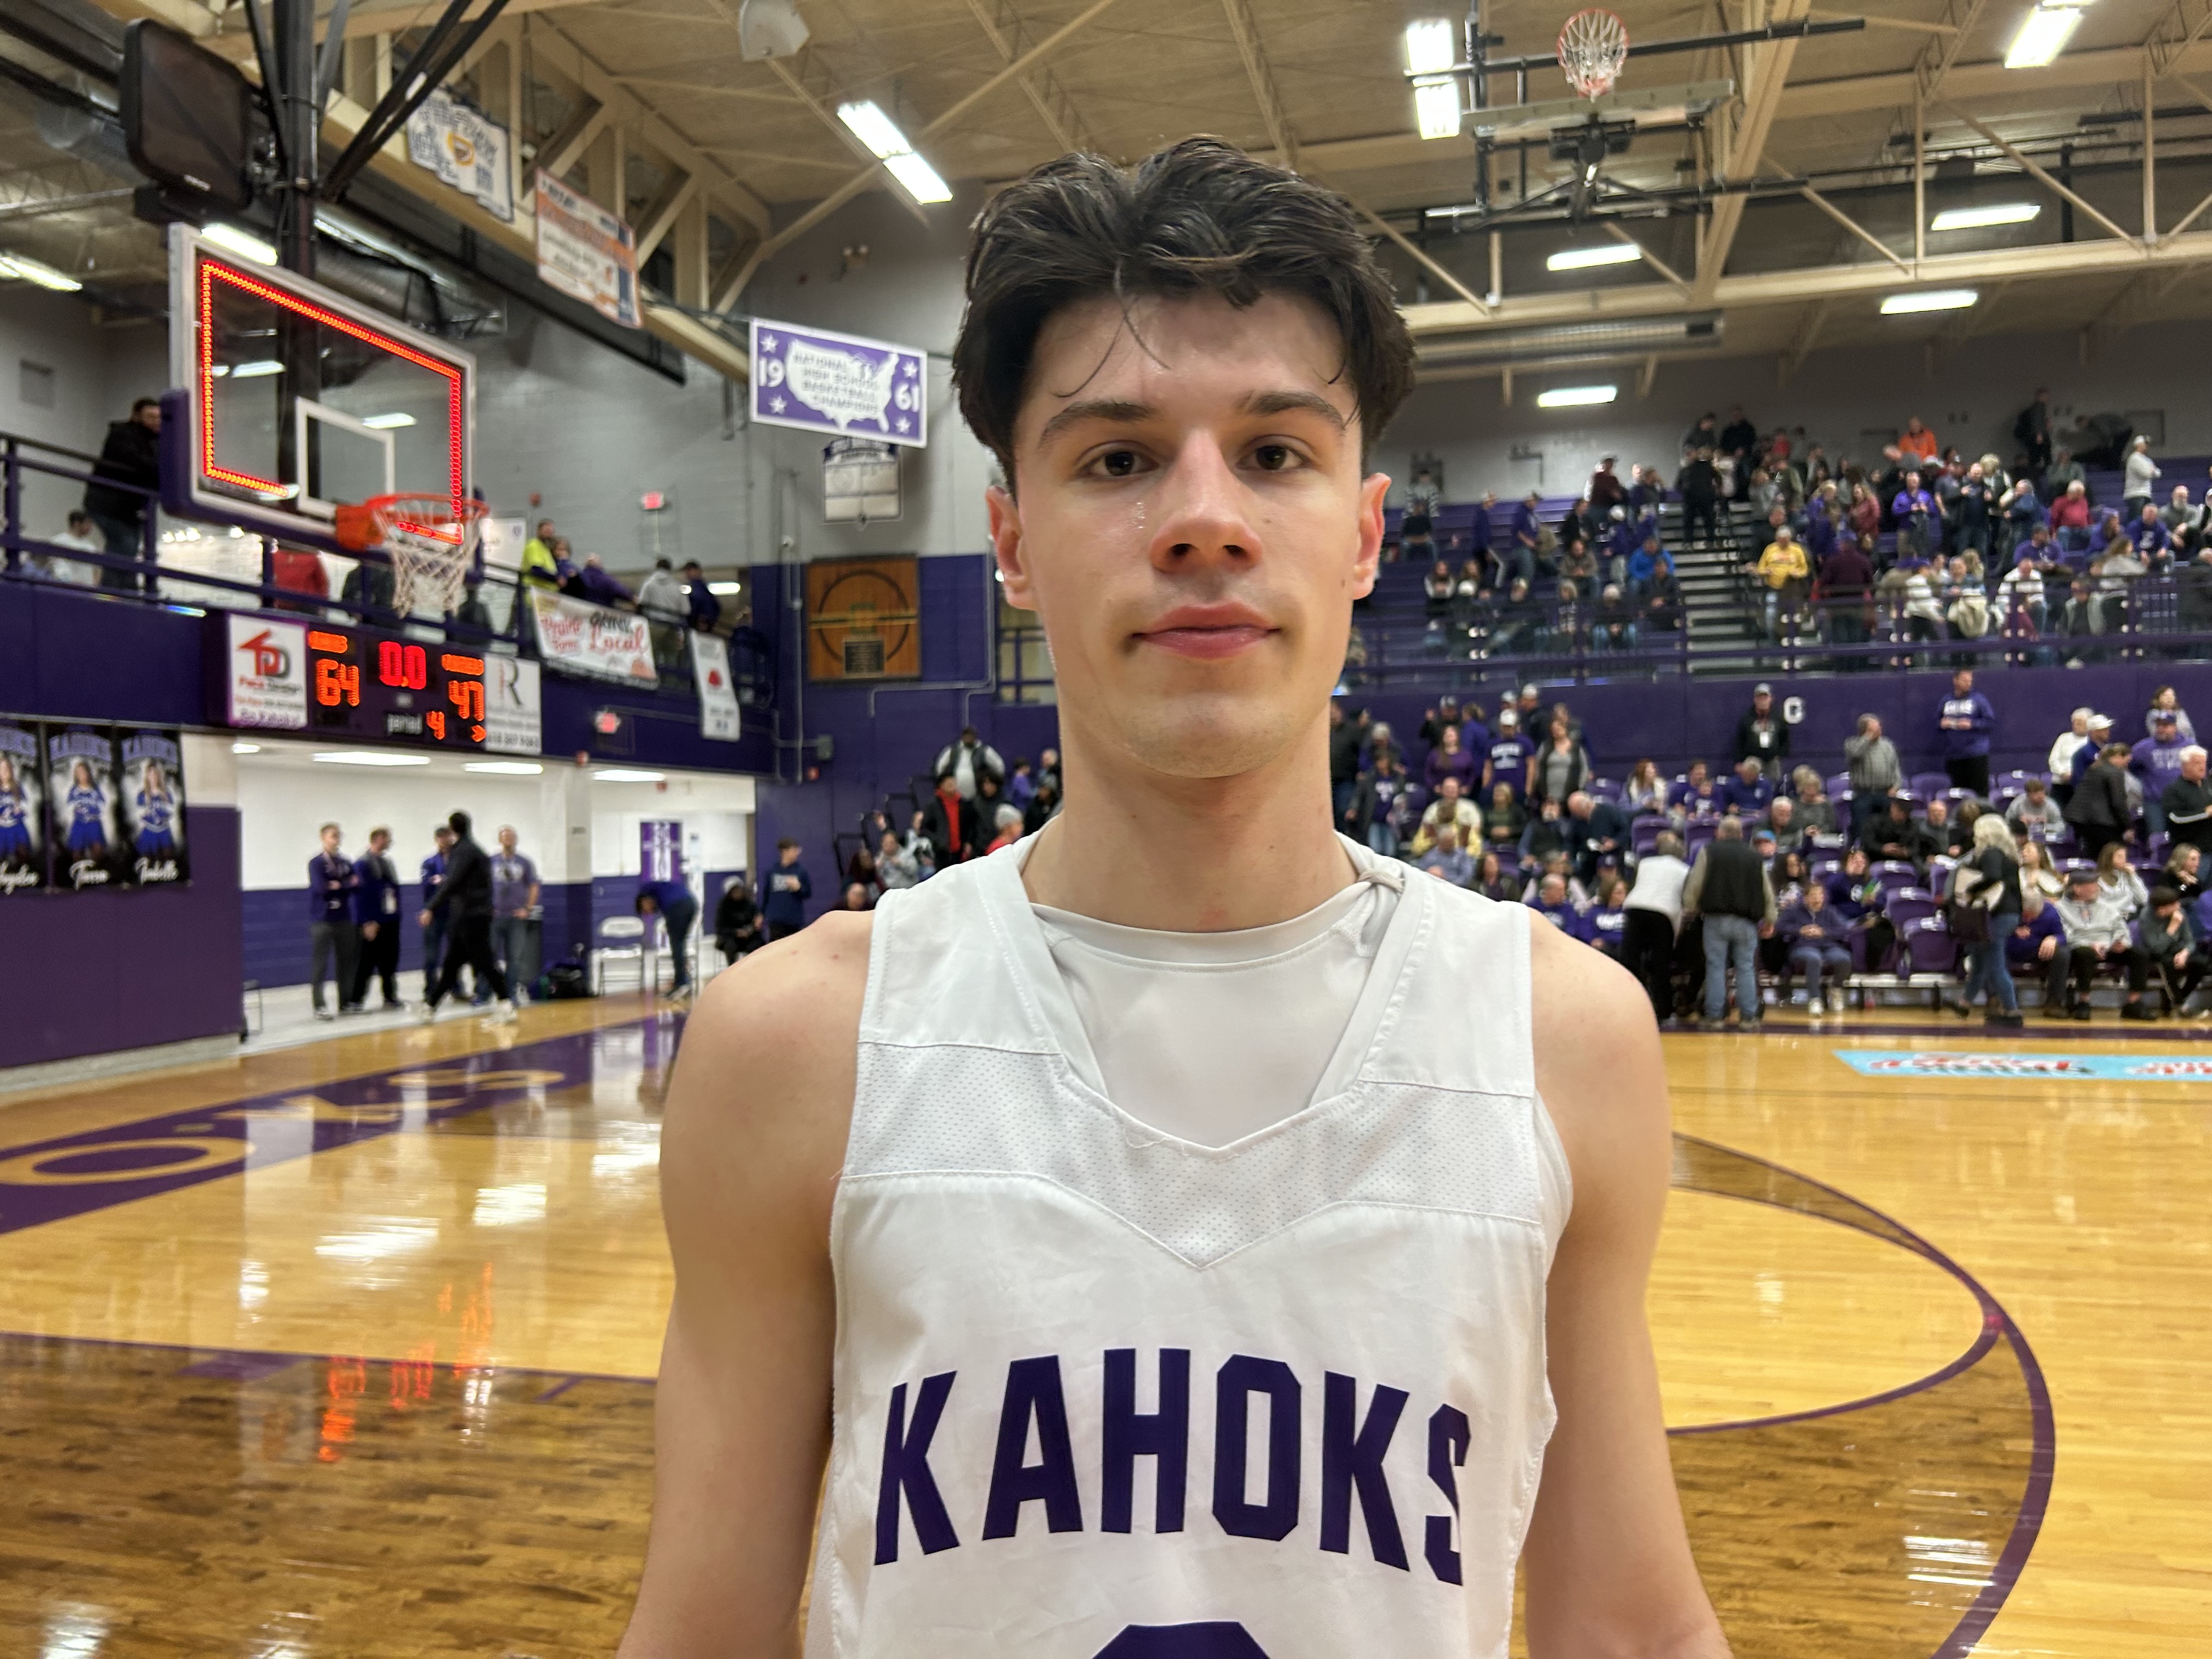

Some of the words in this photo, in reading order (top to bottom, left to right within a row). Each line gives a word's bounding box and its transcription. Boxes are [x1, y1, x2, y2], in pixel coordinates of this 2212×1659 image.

[758, 357, 785, 387] 19
[894, 382, 919, 412] 61
[315, 658, 360, 707] 64
[448, 680, 484, 721] 47
[426, 710, 445, 740] 4
[873, 1347, 1471, 1586] KAHOKS
